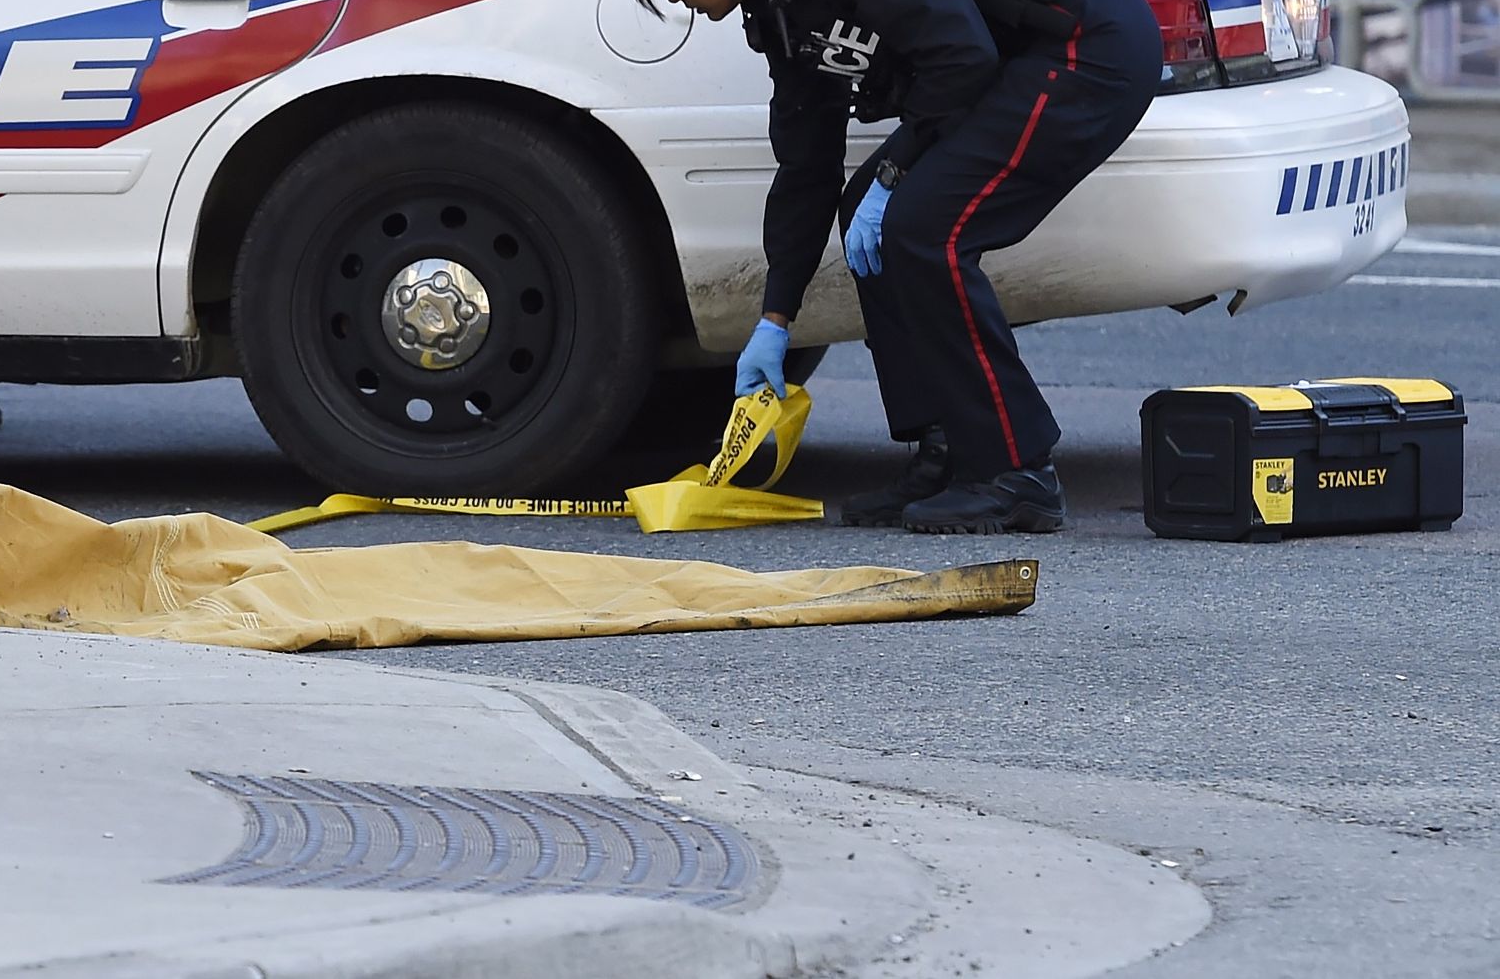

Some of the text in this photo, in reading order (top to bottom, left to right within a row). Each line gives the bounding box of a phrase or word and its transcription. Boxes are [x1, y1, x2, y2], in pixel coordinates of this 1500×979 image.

[817, 19, 880, 86] ICE
[728, 416, 757, 467] POLICE
[1255, 461, 1285, 469] STANLEY
[1317, 468, 1388, 490] STANLEY
[568, 500, 625, 514] POLICE
